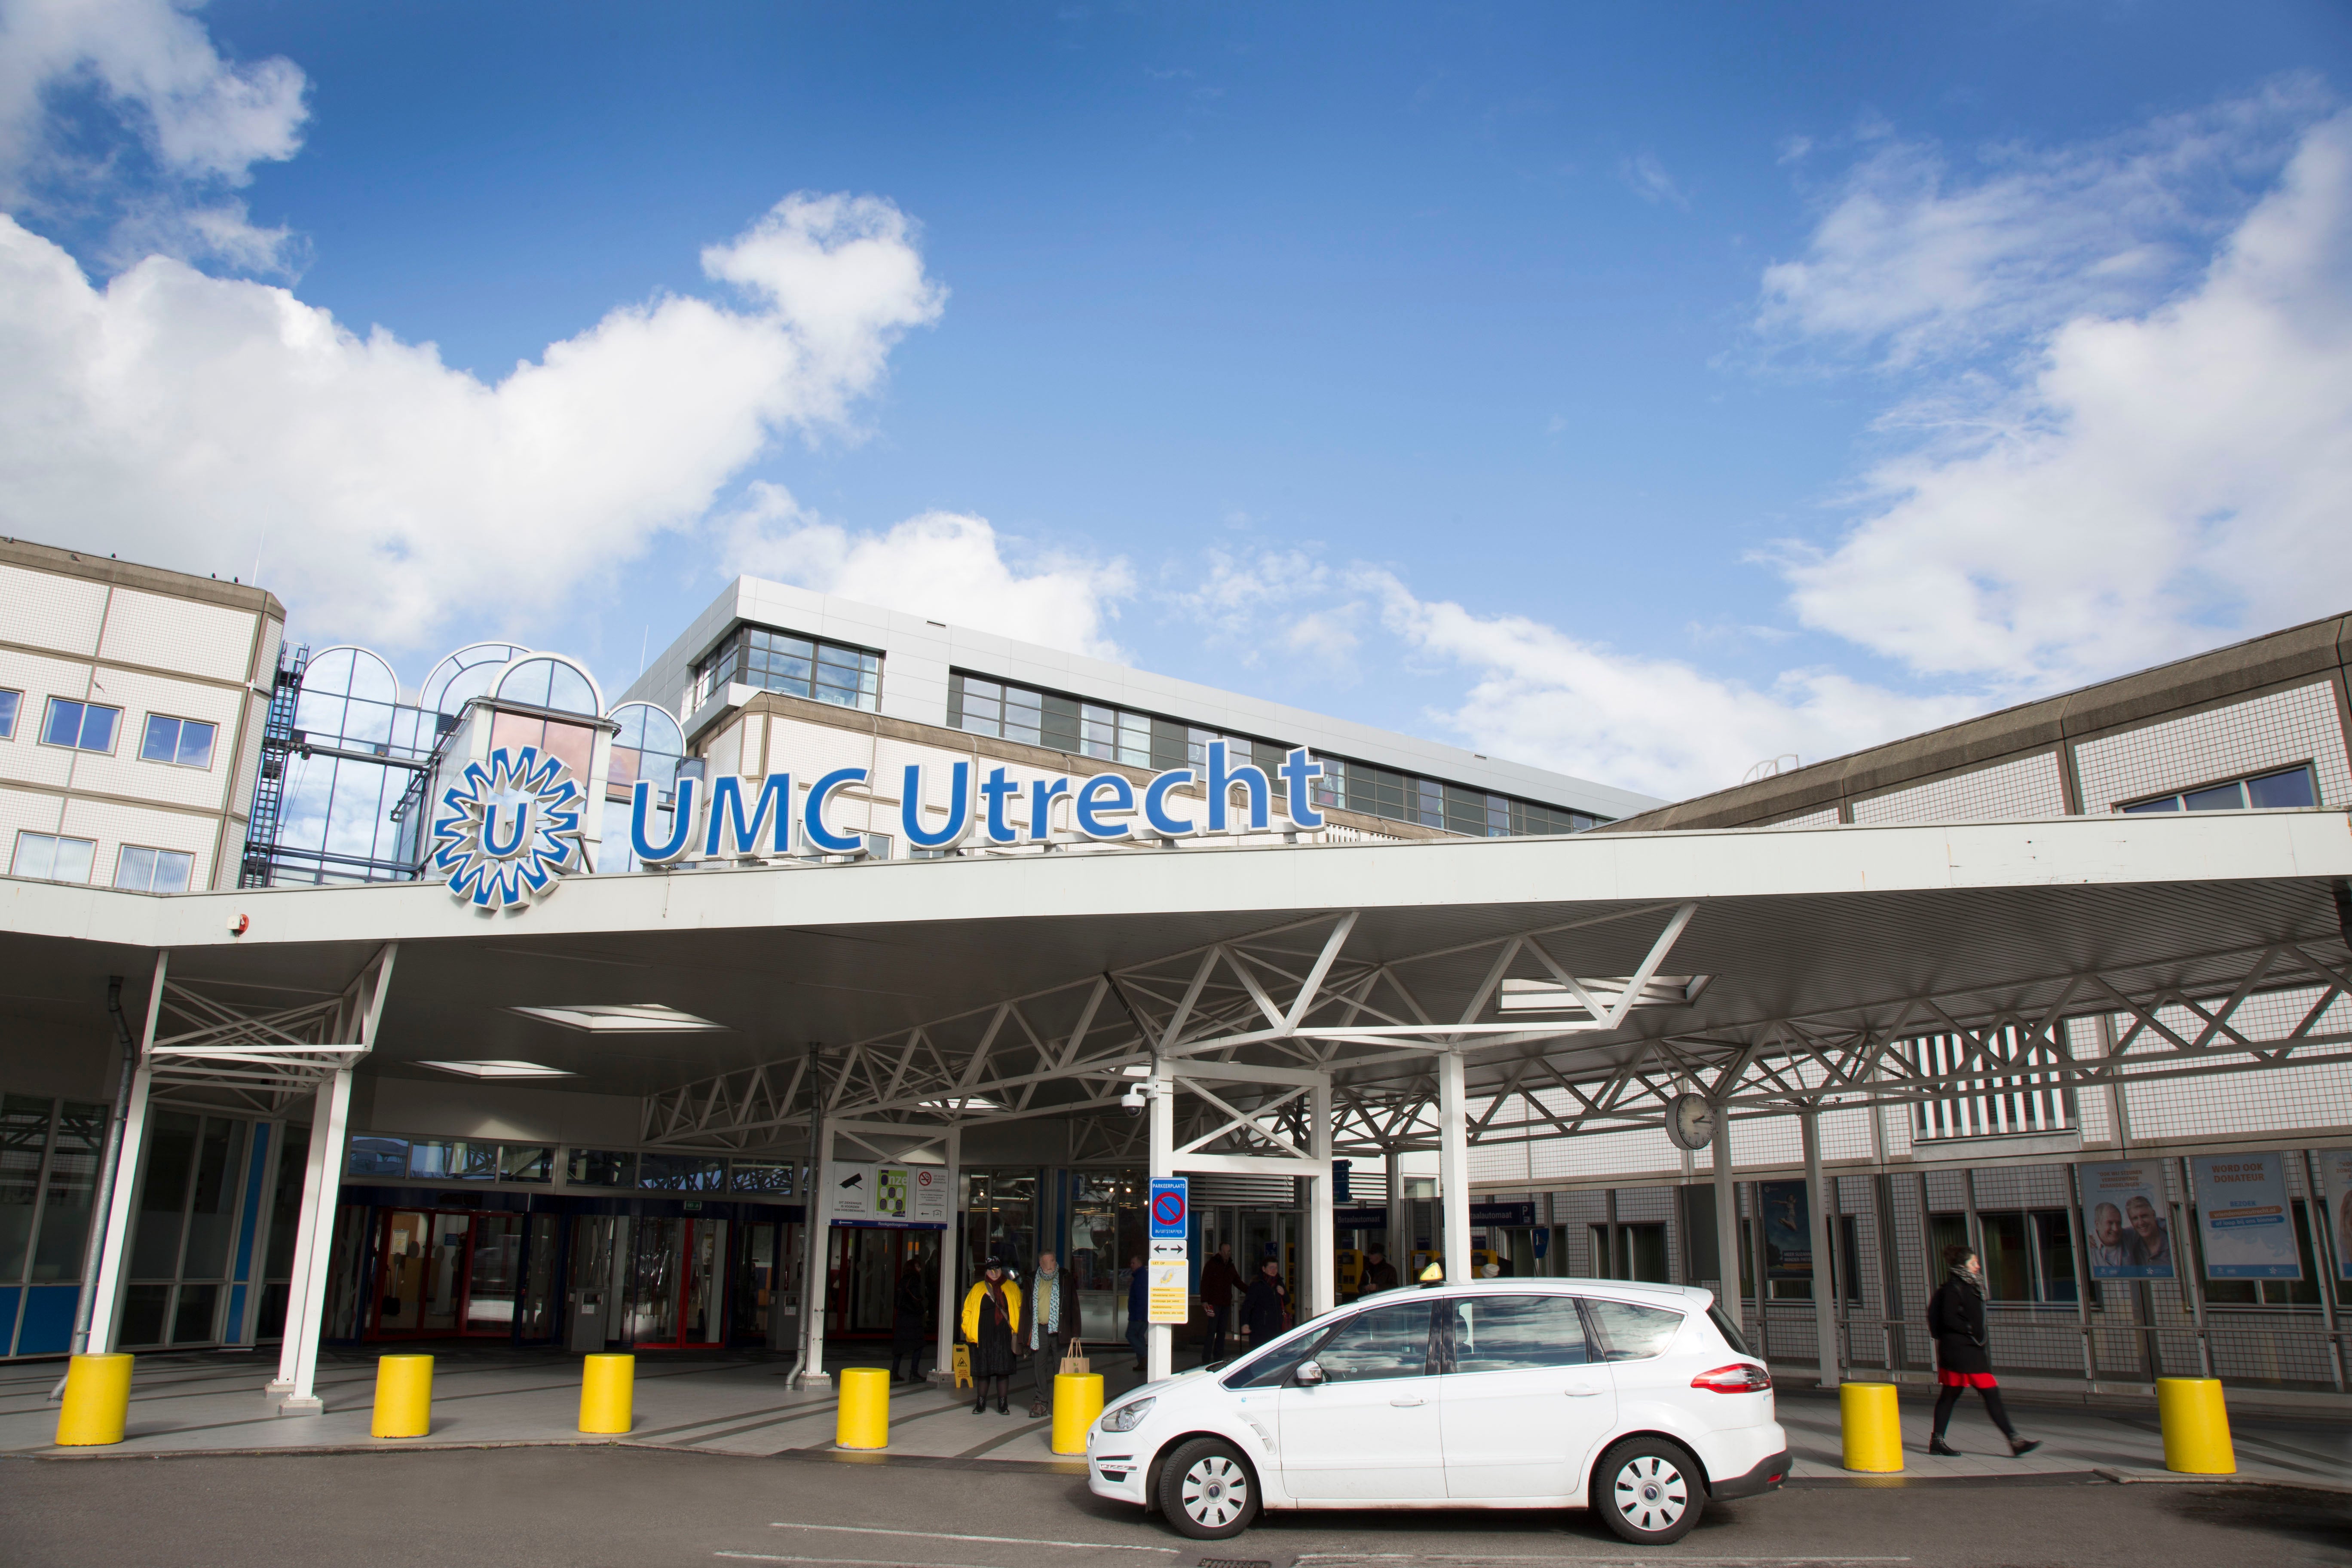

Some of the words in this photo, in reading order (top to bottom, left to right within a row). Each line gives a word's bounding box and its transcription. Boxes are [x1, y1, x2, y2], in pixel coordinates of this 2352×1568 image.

[629, 767, 874, 864] UMC
[901, 738, 1325, 851] Utrecht
[2212, 1164, 2240, 1173] WORD
[2243, 1163, 2263, 1171] OOK
[2214, 1173, 2265, 1182] DONATEUR
[1522, 1206, 1528, 1215] P
[2214, 1208, 2276, 1217] vriendenumcutrecht.nl
